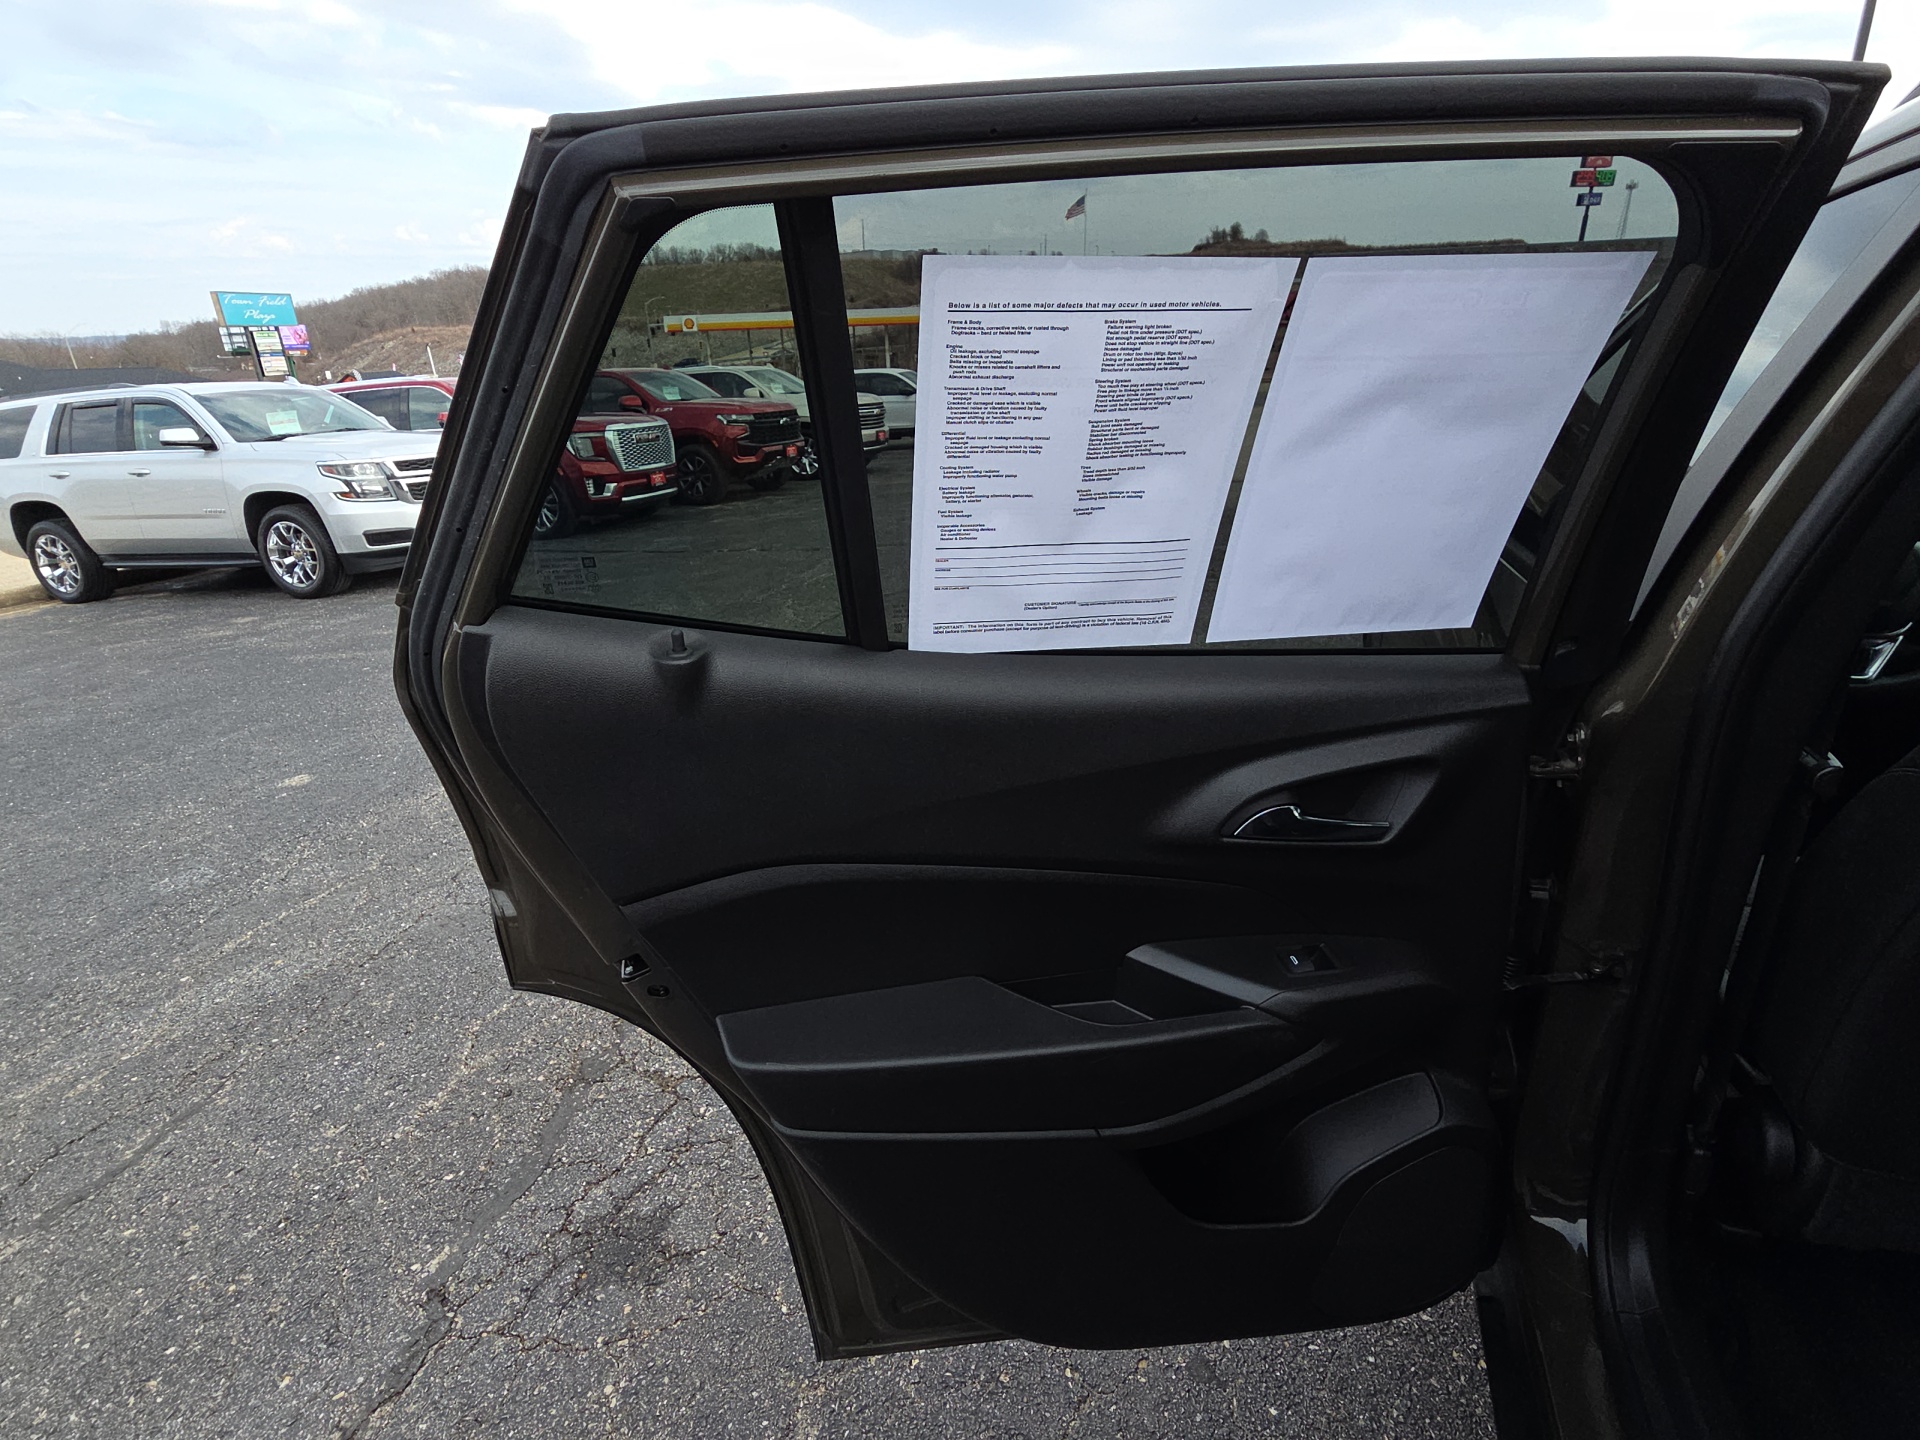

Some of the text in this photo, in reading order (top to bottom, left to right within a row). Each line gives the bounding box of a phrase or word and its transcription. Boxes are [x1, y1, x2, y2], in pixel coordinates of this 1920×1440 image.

[223, 294, 287, 306] Town Field
[1057, 301, 1083, 309] defects
[1102, 300, 1116, 308] may
[1118, 300, 1138, 308] occur
[1140, 300, 1147, 308] in
[1149, 300, 1167, 308] used
[1168, 300, 1188, 308] motor
[1191, 300, 1222, 308] vehicles.
[244, 309, 276, 324] Plaza
